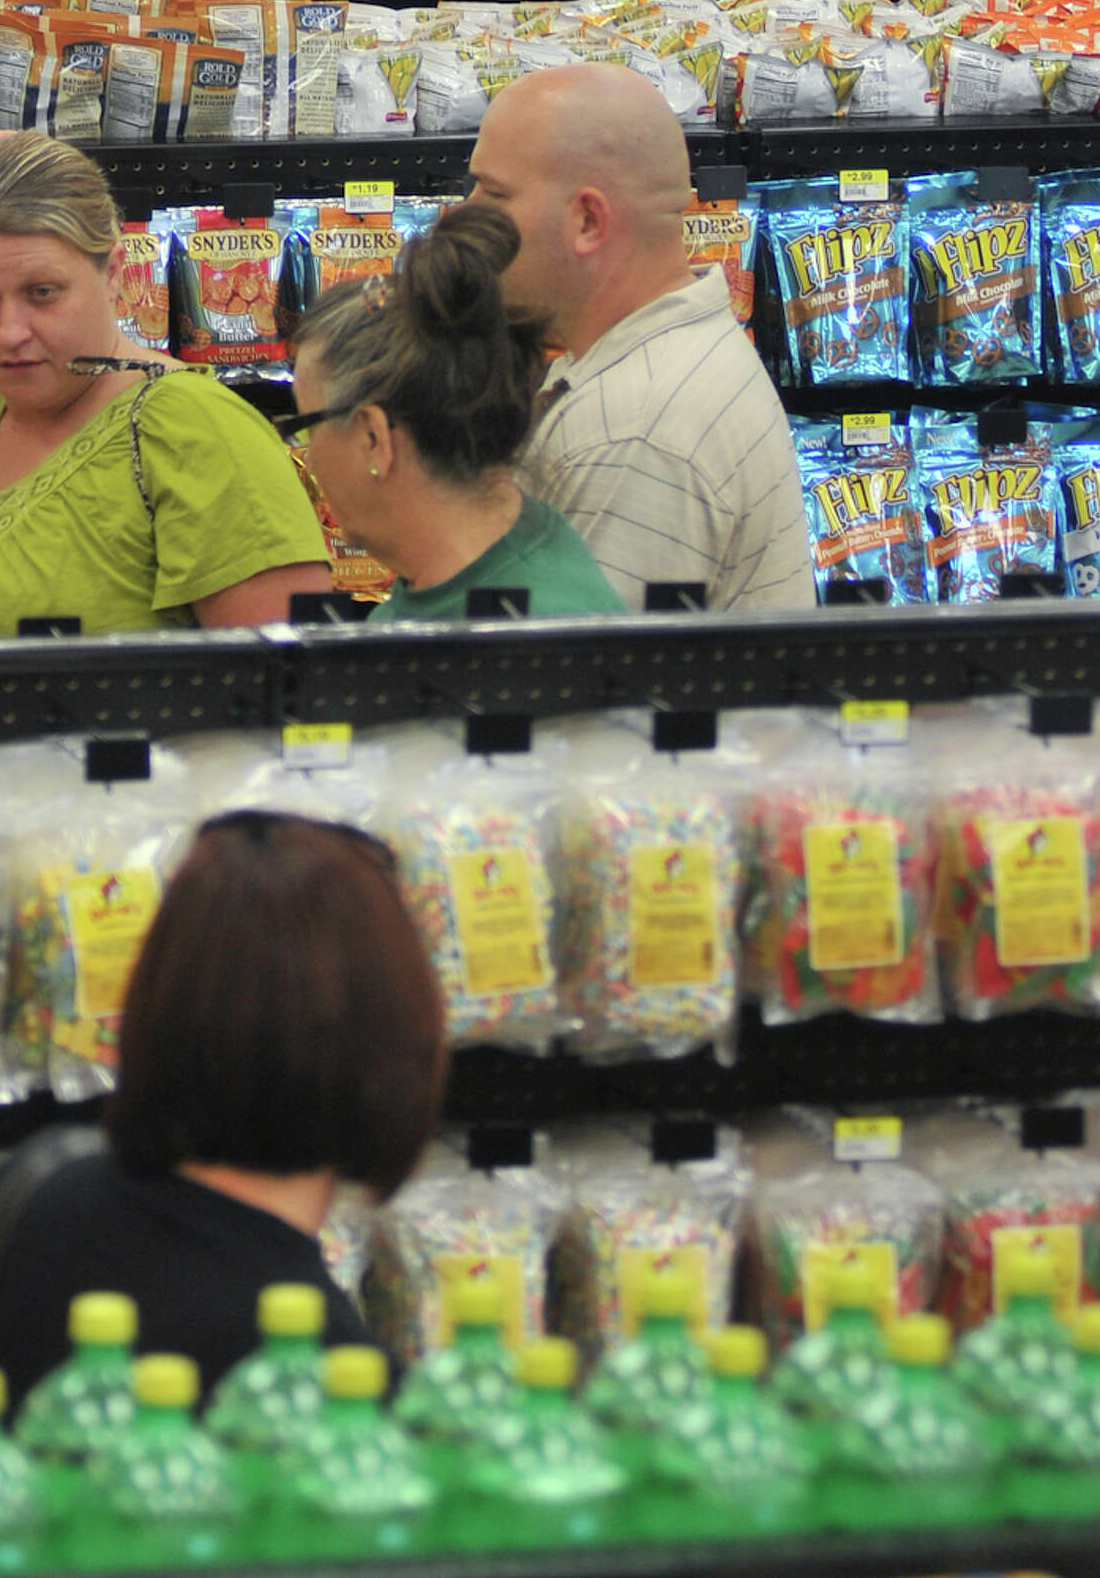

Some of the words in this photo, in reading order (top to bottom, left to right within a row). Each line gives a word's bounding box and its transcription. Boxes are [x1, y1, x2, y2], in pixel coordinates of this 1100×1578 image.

[203, 61, 237, 73] ROLD
[199, 71, 237, 85] GOLD
[685, 217, 744, 236] YDER'S
[192, 232, 274, 252] SNYDER'S
[314, 231, 398, 251] SNYDER'S
[788, 220, 893, 295] Flipz
[932, 220, 1027, 292] Flipz
[810, 290, 836, 308] Milk
[955, 287, 977, 306] Milk
[800, 436, 828, 449] New!
[814, 469, 908, 537] Flipz
[931, 465, 1041, 537] Flipz
